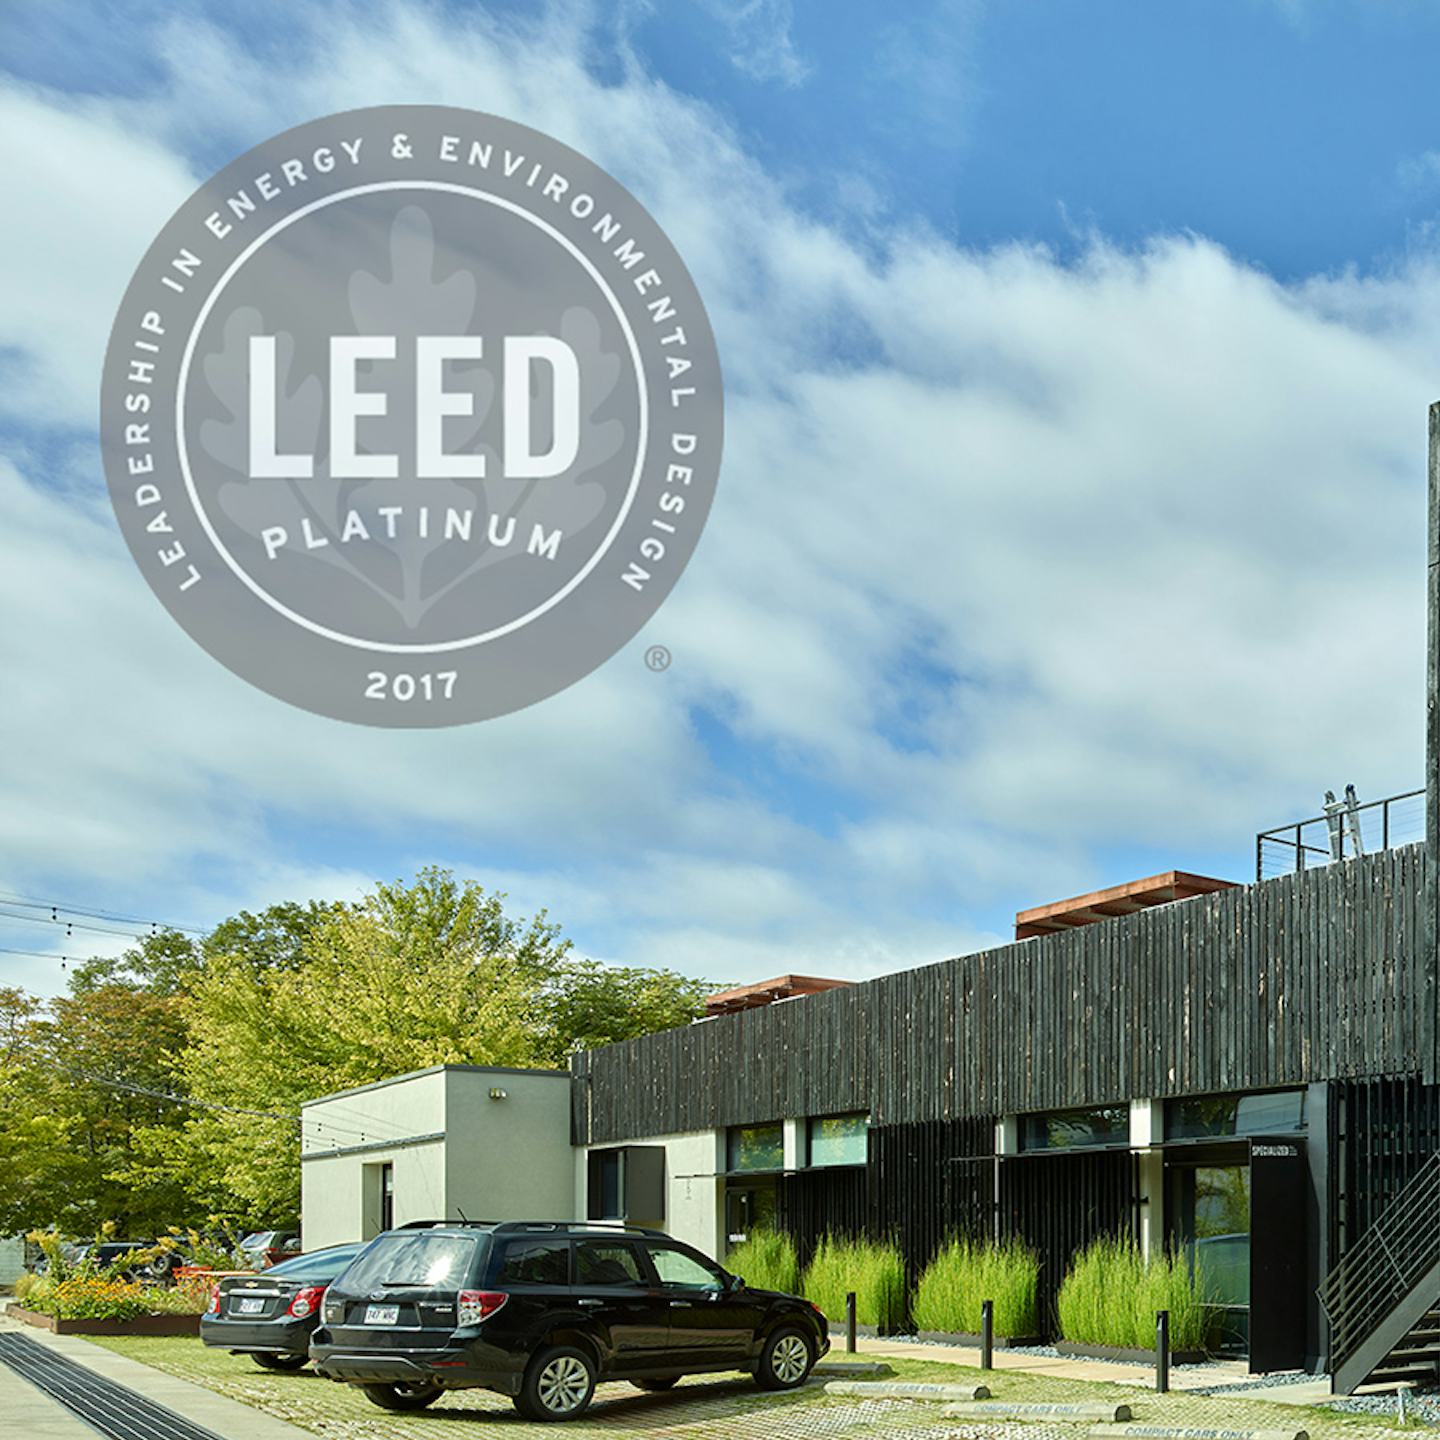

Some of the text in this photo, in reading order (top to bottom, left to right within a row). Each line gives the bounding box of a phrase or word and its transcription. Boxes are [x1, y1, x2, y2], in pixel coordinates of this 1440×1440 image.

[1125, 1427, 1254, 1440] COMPACT CARS ONLY
